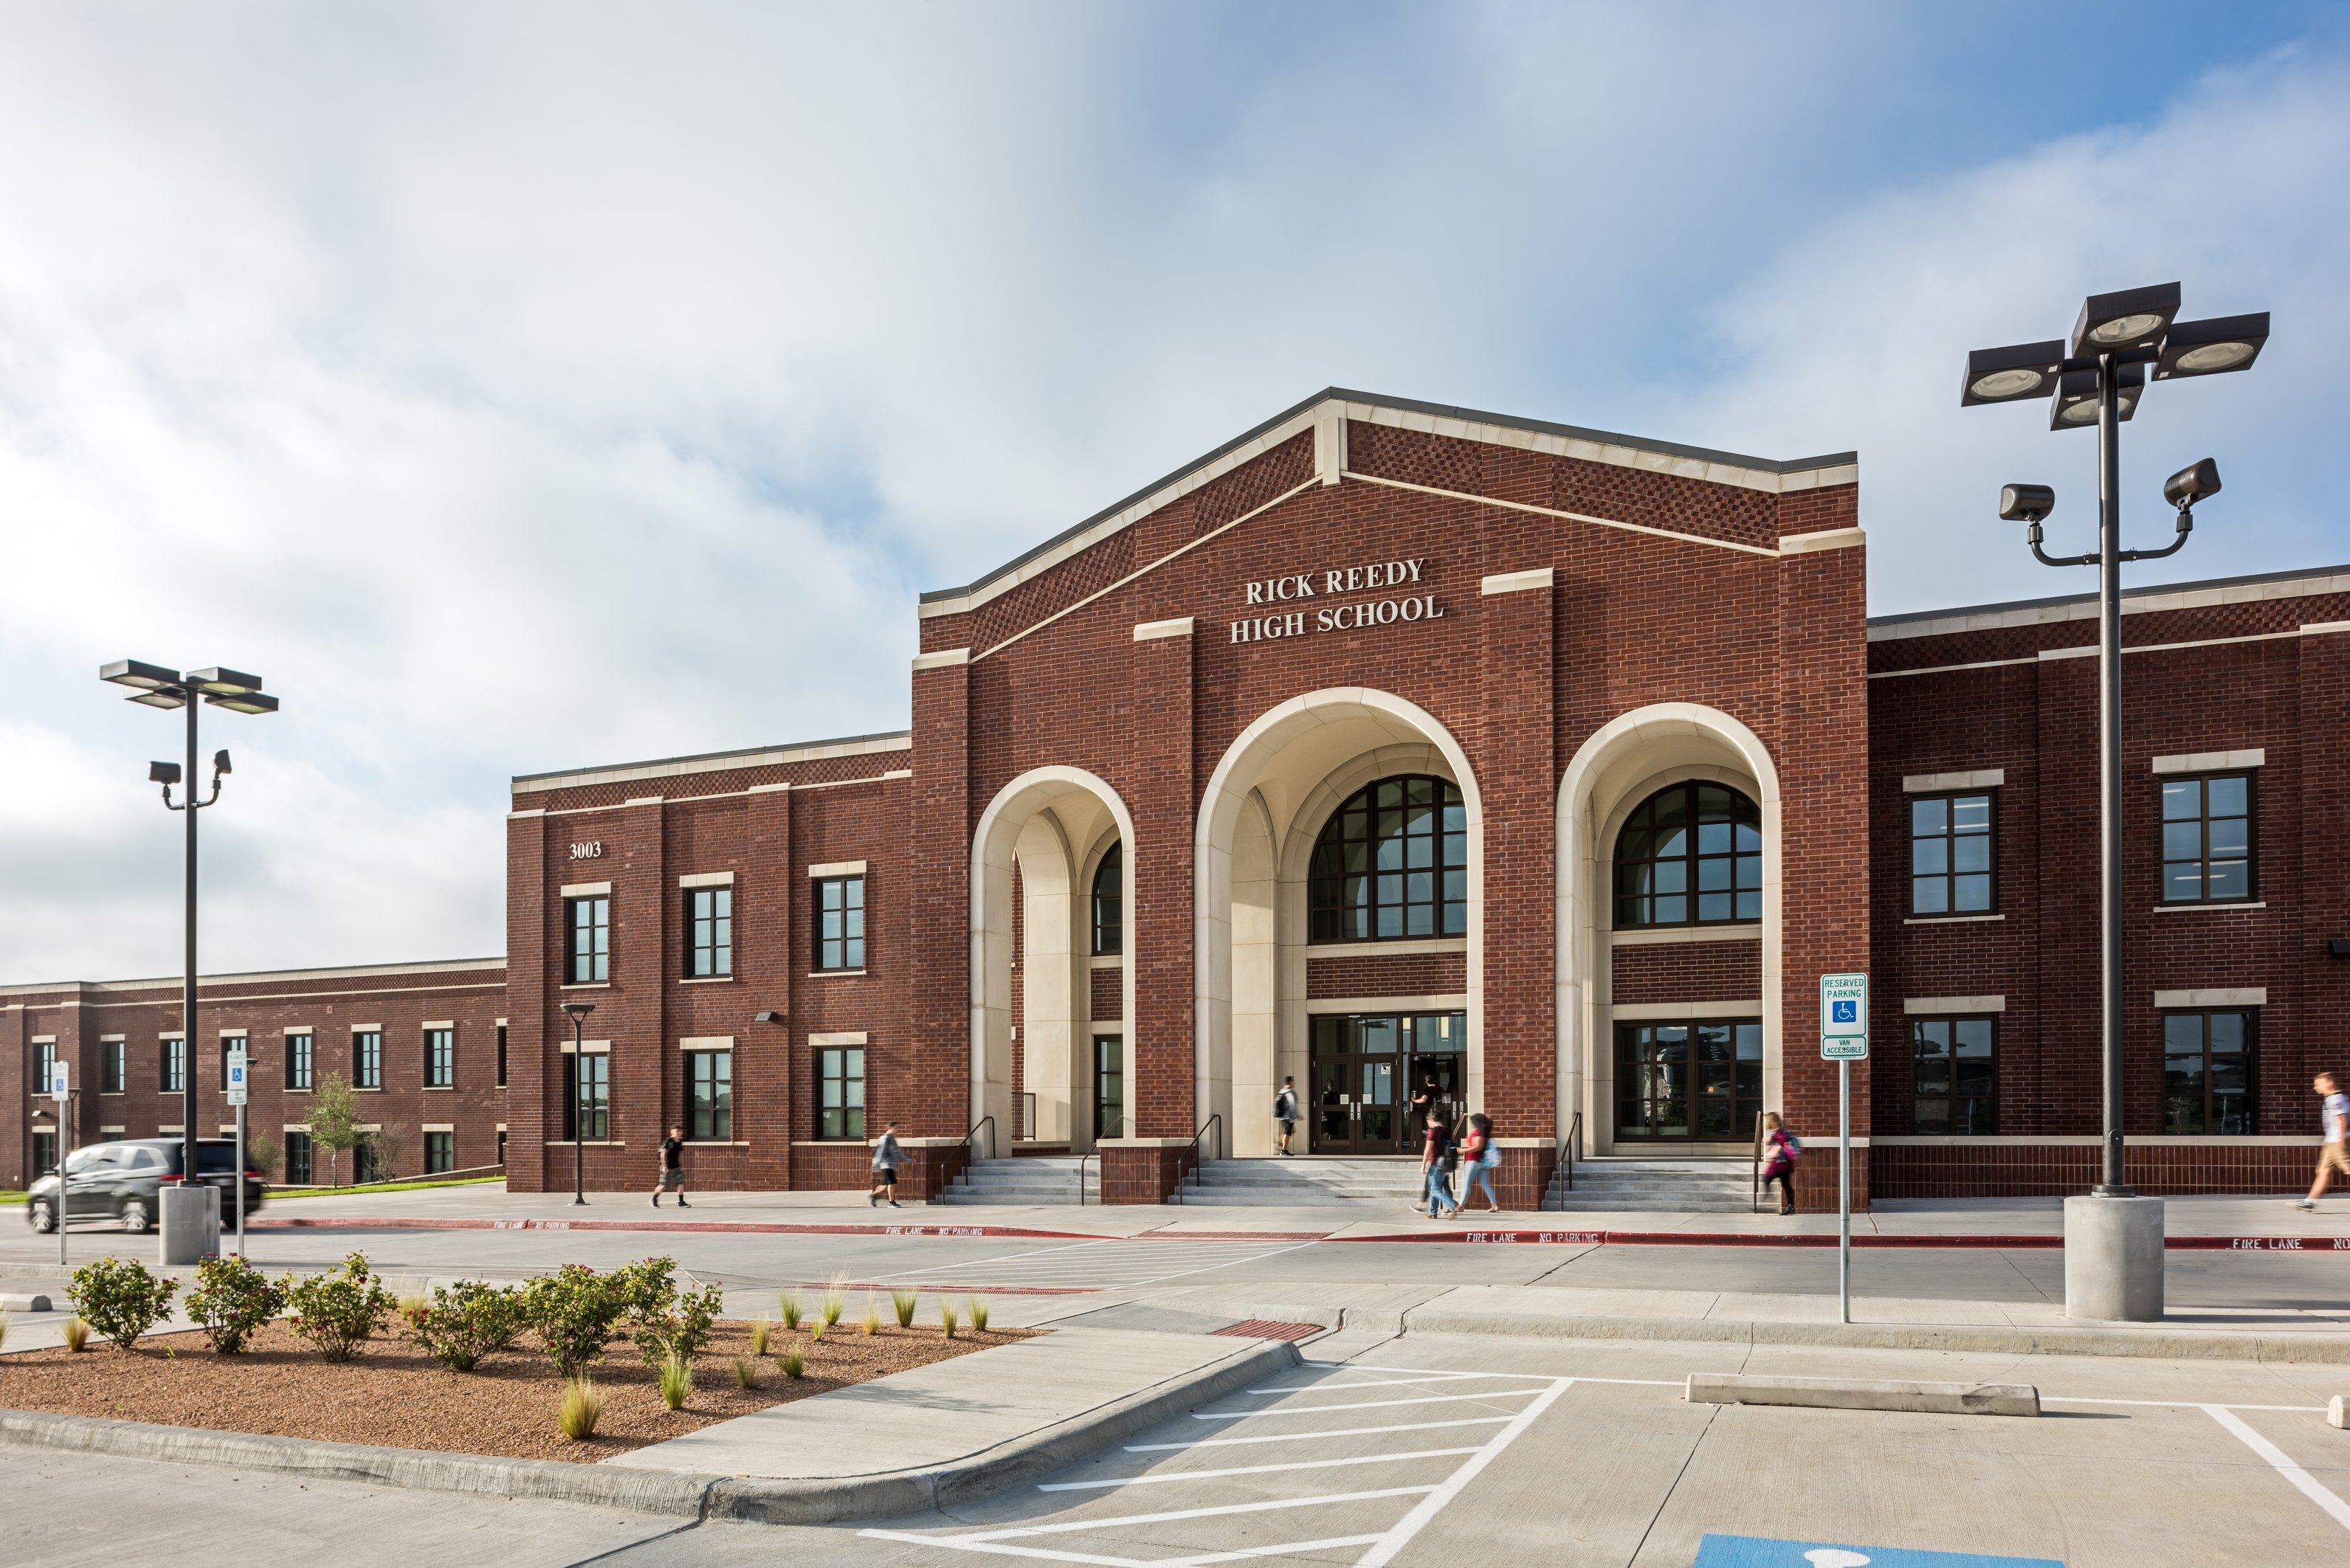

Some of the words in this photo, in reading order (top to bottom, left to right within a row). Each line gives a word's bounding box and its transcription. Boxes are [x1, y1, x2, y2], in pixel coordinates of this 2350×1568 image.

[1245, 573, 1316, 605] RICK
[1324, 557, 1426, 594] REEDY
[1229, 612, 1306, 644] HIGH
[1317, 595, 1444, 632] SCHOOL
[569, 841, 602, 860] 3003
[1824, 978, 1864, 988] RESERVED
[1827, 990, 1861, 998] PARKING
[534, 1221, 543, 1229] NO
[545, 1222, 570, 1230] PARKING
[886, 1226, 903, 1234] FIRE
[905, 1226, 923, 1235] LANE
[939, 1227, 949, 1235] NO
[952, 1227, 983, 1236] PARKING
[1467, 1232, 1488, 1243] FIRE
[1492, 1233, 1517, 1243] LANE
[1539, 1233, 1552, 1243] NO
[1557, 1233, 1598, 1243] PARKING
[2233, 1238, 2262, 1249] FIRE
[2269, 1238, 2304, 1249] LANE
[2333, 1238, 2350, 1249] NO
